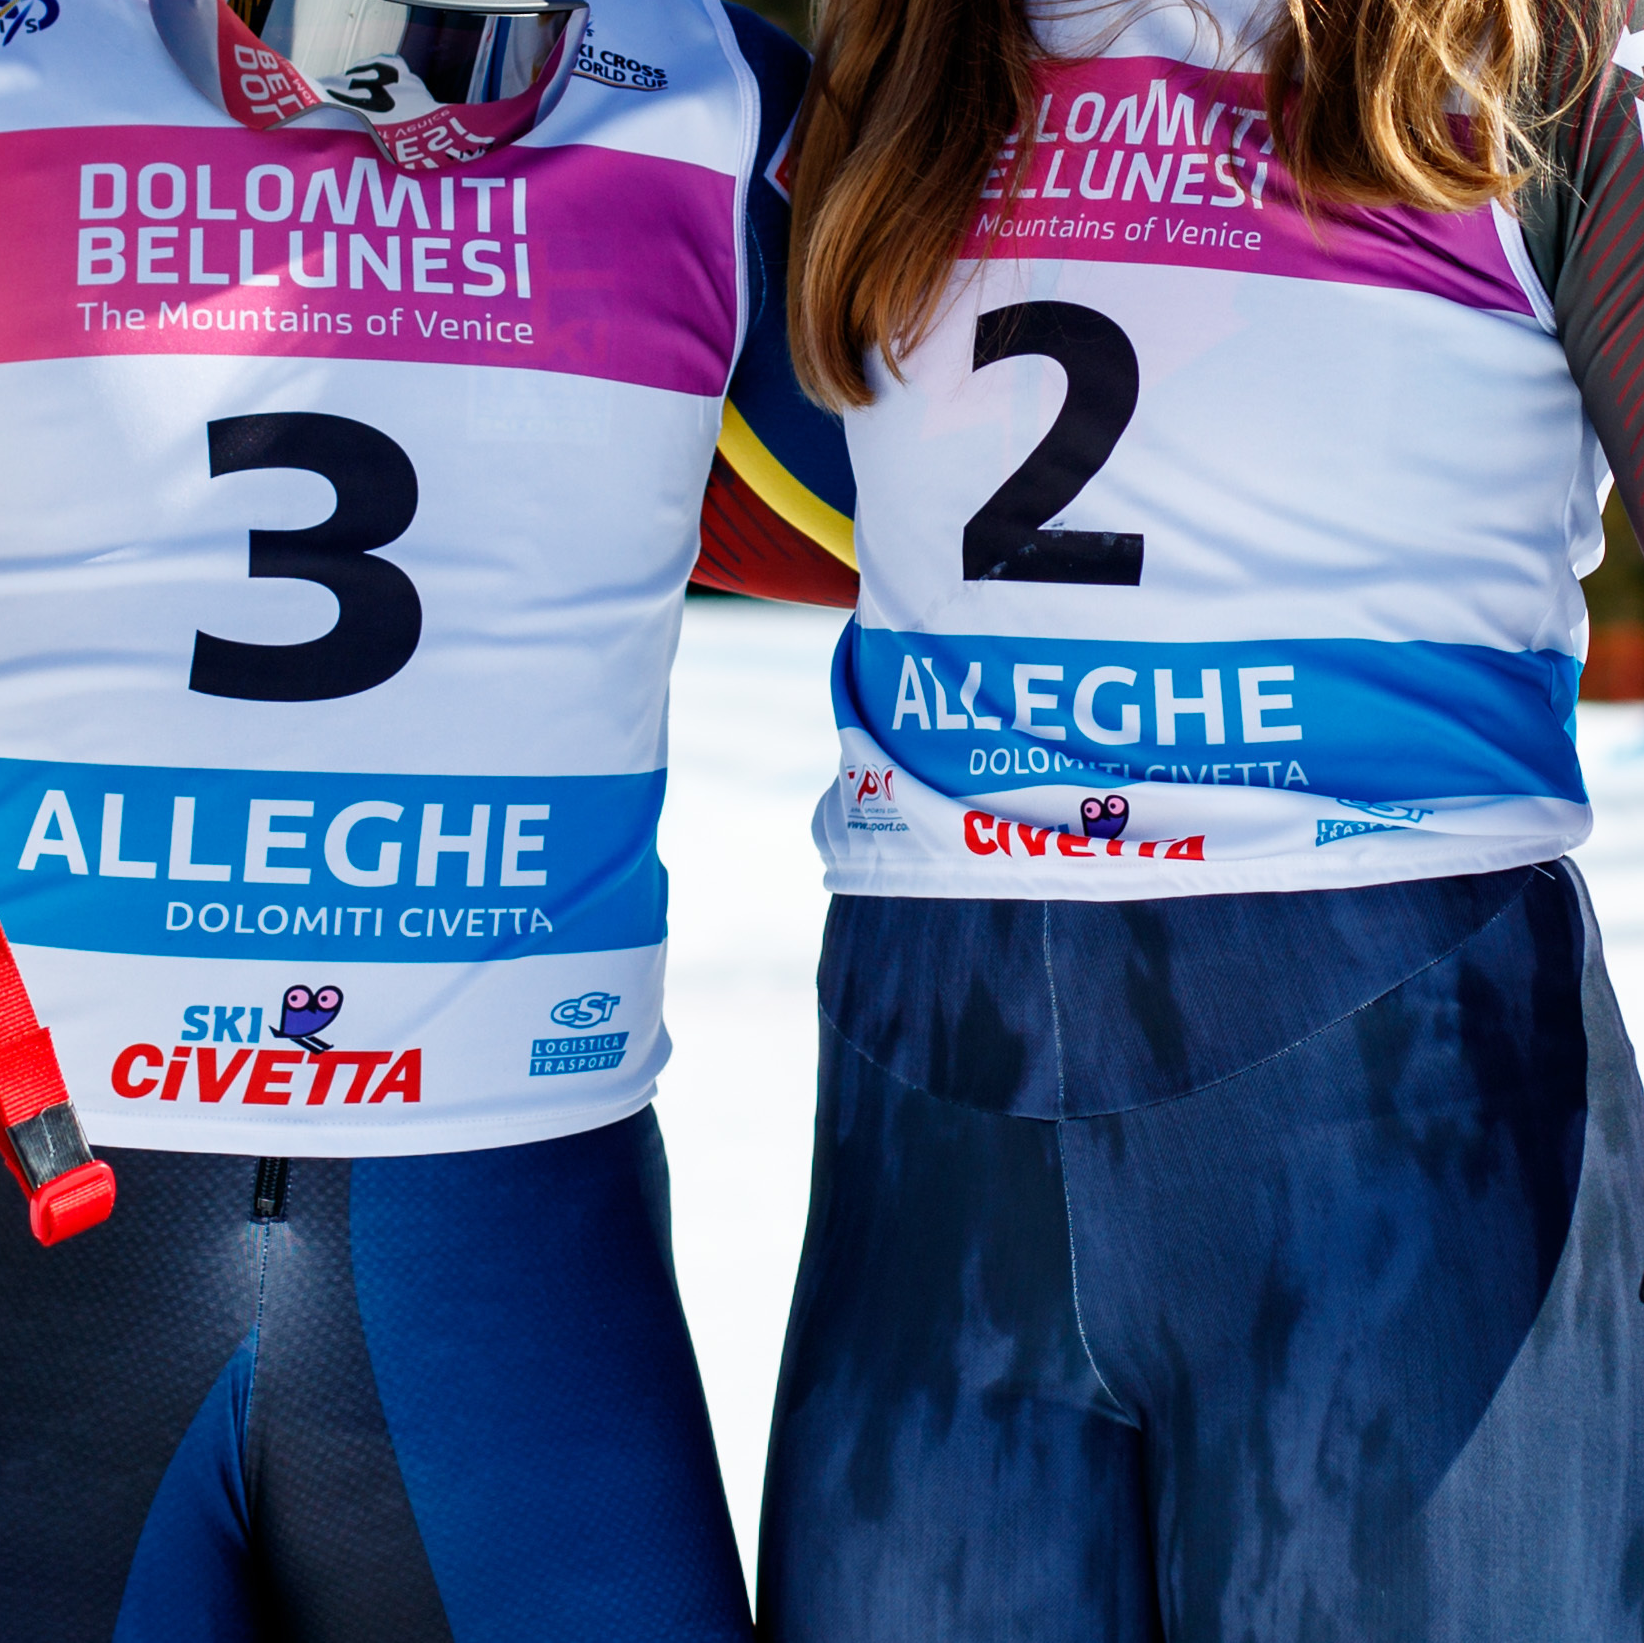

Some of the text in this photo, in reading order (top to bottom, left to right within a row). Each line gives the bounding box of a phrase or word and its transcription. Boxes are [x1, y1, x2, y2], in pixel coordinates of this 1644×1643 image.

[578, 58, 668, 88] ORLD CUP
[600, 50, 667, 80] CROSS
[979, 149, 1268, 210] ELLUNESI
[975, 213, 1262, 250] Mountains of Venice
[76, 227, 532, 299] BELLUNESI
[77, 300, 535, 345] The Mountains of Venice
[963, 300, 1145, 587] 2
[188, 411, 422, 703] 3
[891, 653, 1304, 747] ALLEGHE
[18, 789, 552, 888] ALLEGHE
[165, 901, 555, 939] DOLOMITI CIVETTA
[181, 1005, 264, 1044] SKI
[550, 991, 621, 1030] CST
[534, 1054, 619, 1073] TRASPORTI
[535, 1036, 620, 1054] LOGISTICA
